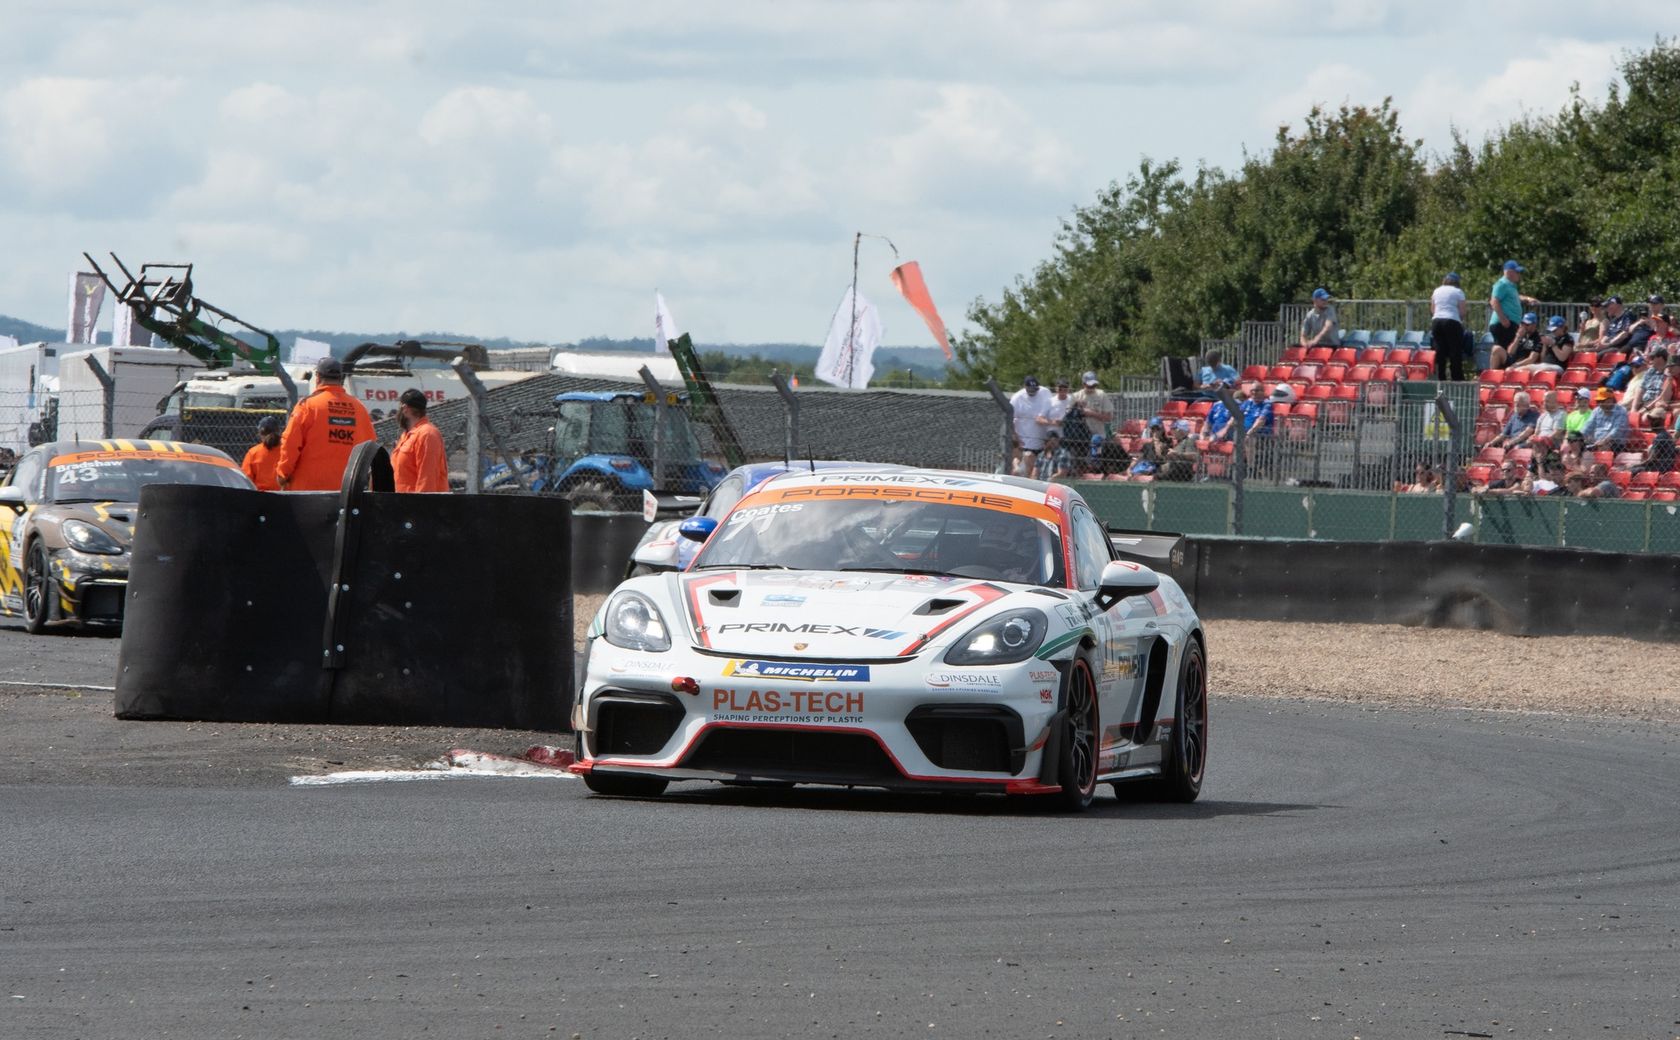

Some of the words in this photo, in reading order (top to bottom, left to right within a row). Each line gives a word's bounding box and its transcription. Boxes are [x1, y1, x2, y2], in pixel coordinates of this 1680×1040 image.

[365, 389, 398, 401] FOR
[328, 429, 355, 441] NGK
[76, 450, 214, 463] PORSCHE
[55, 460, 124, 474] Bradshaw
[58, 467, 100, 485] 43
[820, 475, 944, 485] PRIMEX
[781, 487, 1013, 509] PORSCHE
[730, 503, 805, 522] Coates
[718, 622, 861, 636] PRIMEX
[762, 666, 859, 677] MICHELIN
[940, 673, 1000, 684] DINSDALE
[1039, 688, 1053, 700] NGK
[713, 688, 864, 713] PLAS-TECH
[713, 713, 750, 722] SHAPING
[752, 715, 811, 723] PERCEPTIONS
[813, 715, 825, 723] OF
